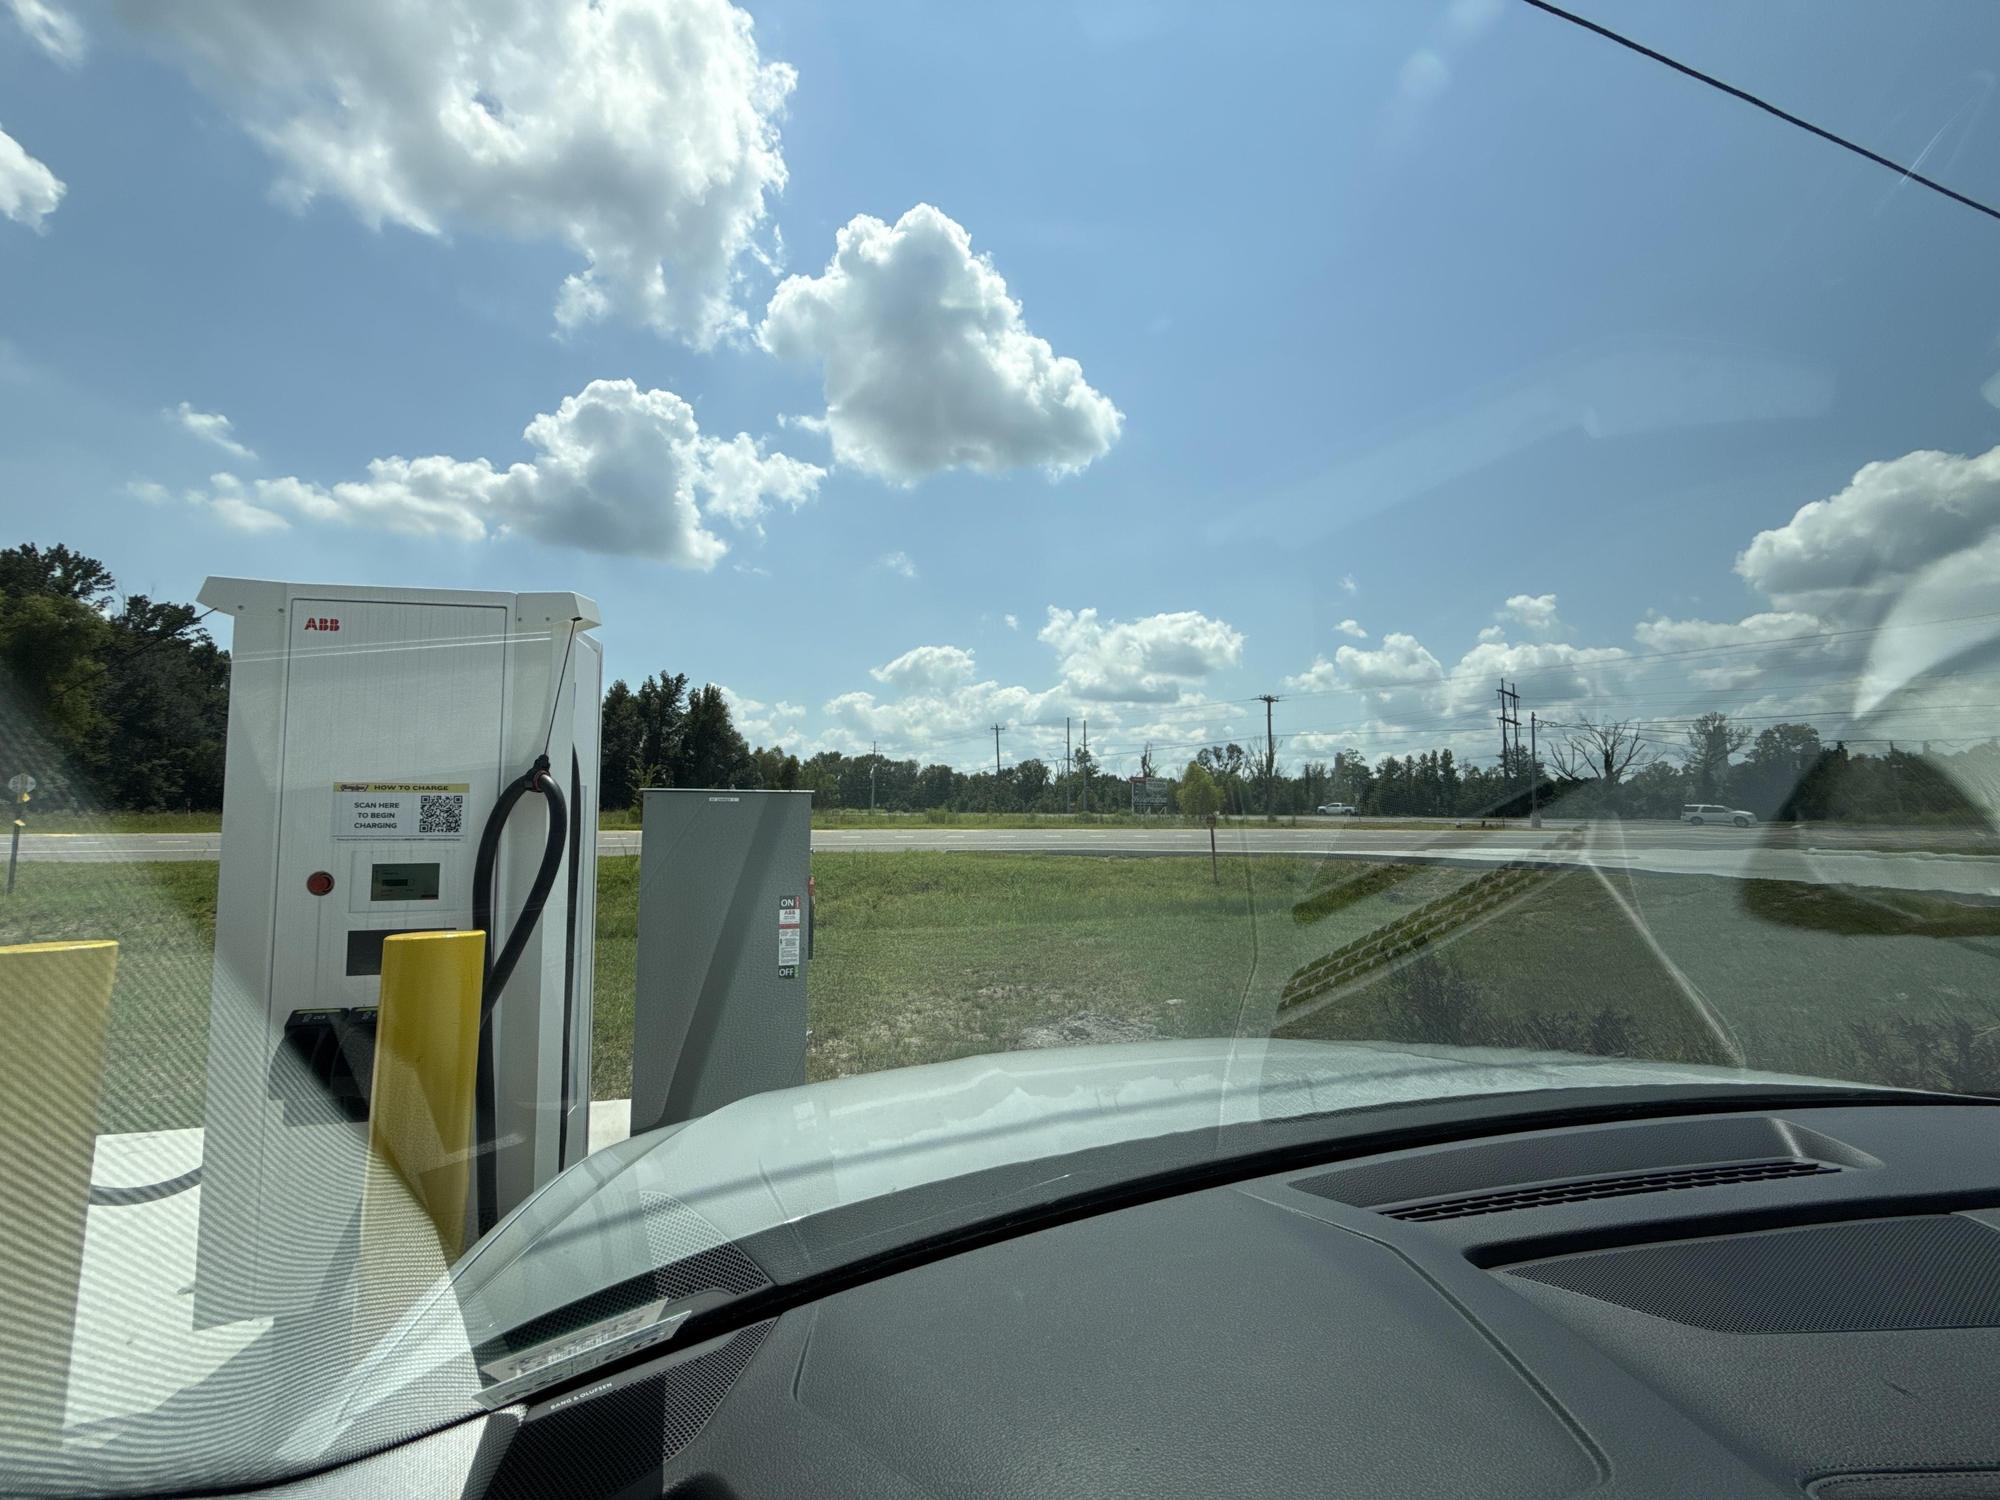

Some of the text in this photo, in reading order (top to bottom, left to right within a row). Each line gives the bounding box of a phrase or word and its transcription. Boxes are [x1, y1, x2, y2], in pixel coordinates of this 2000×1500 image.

[304, 617, 340, 631] ABB
[780, 898, 794, 907] ON
[779, 968, 794, 977] OFF
[550, 1397, 572, 1410] BANG
[579, 1382, 613, 1398] OLUFSEN
